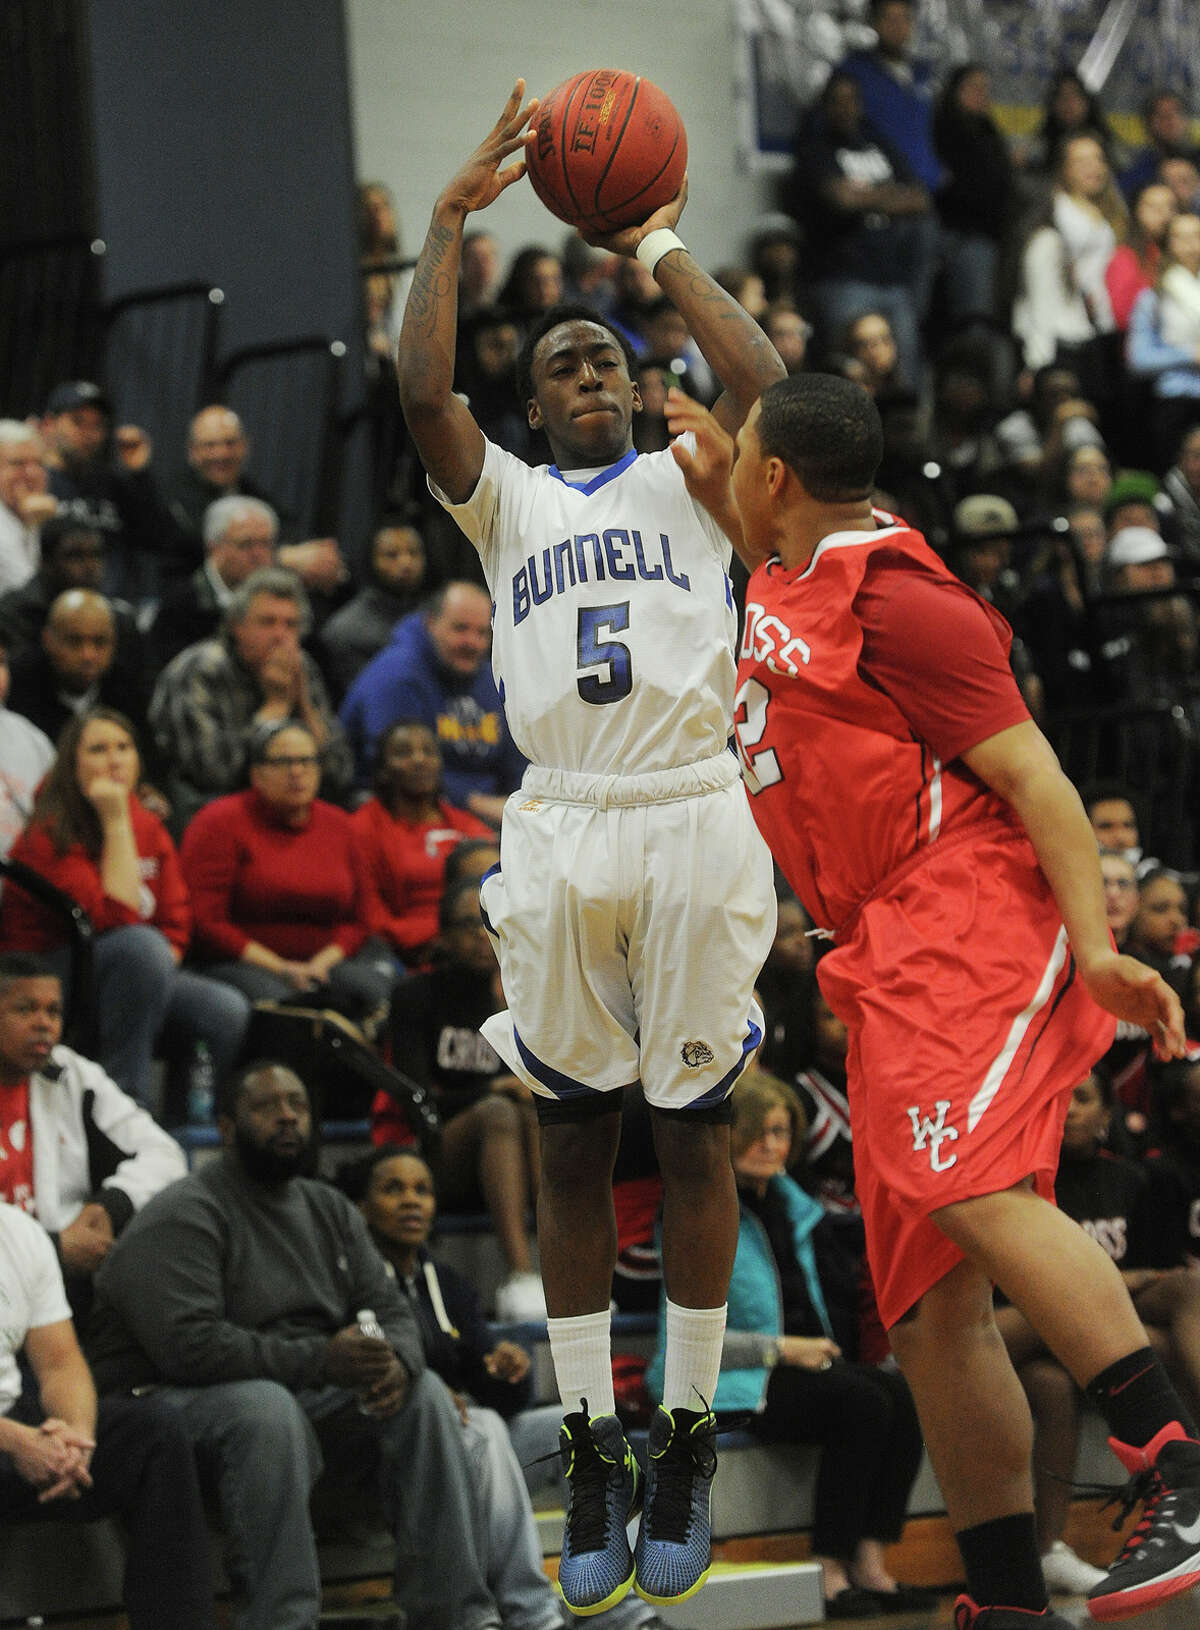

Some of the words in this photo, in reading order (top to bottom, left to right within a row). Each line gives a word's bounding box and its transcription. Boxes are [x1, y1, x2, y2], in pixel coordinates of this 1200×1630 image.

[512, 529, 691, 627] BUNNELL
[577, 600, 633, 705] 5
[740, 602, 811, 679] OSS
[907, 1099, 959, 1173] WC
